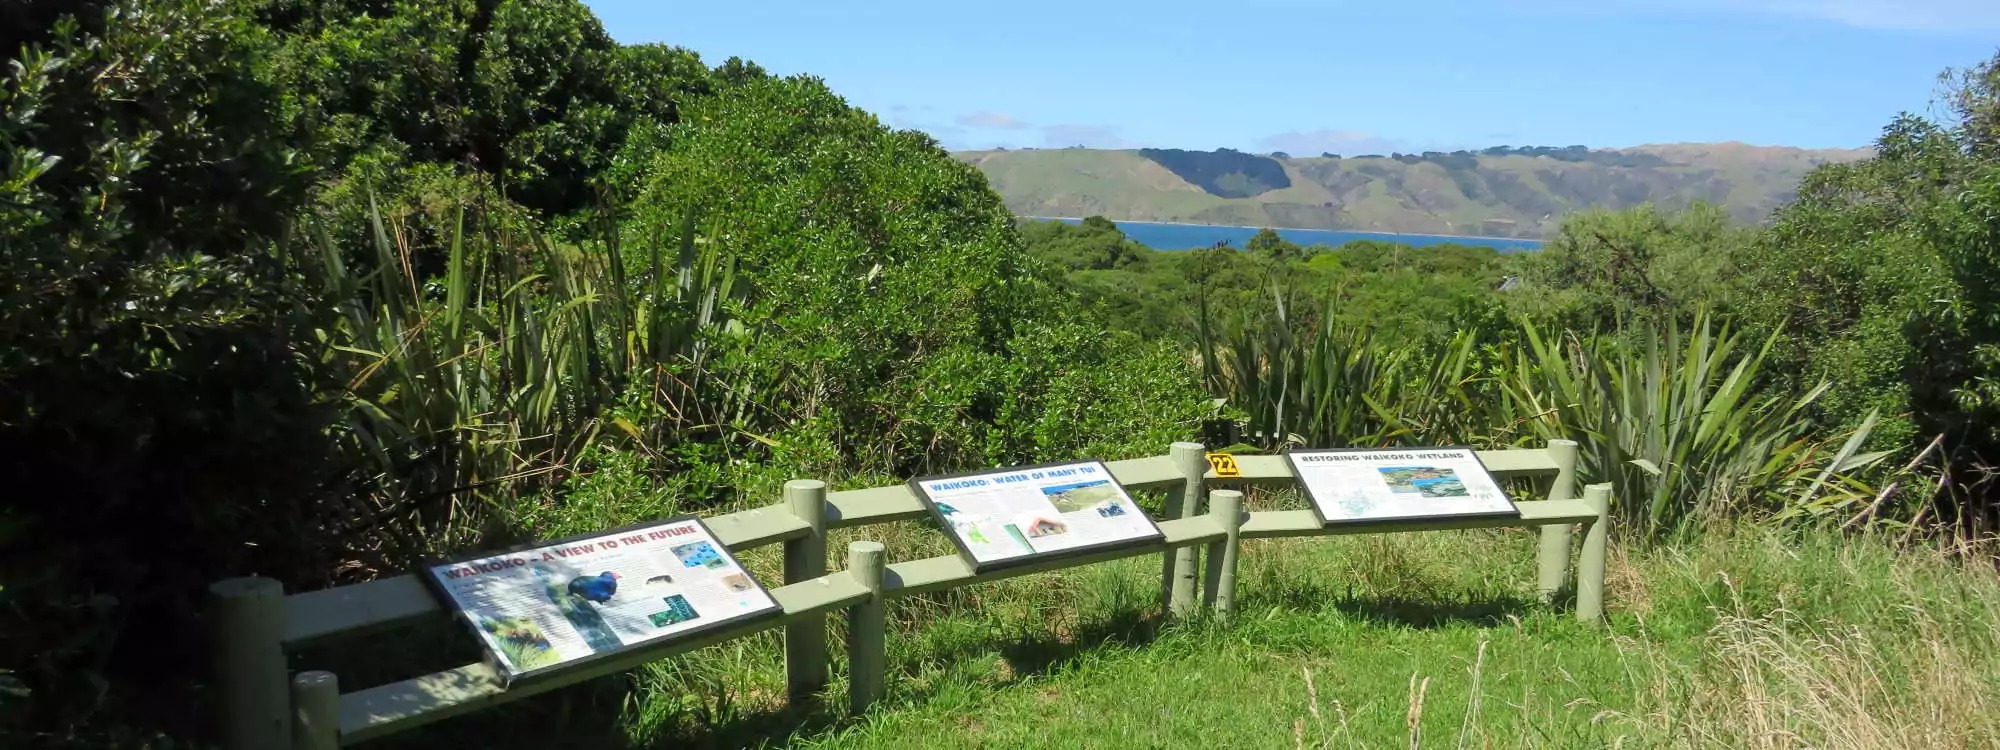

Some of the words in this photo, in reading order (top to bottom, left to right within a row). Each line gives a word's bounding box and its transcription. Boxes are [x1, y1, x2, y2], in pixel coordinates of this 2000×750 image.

[1212, 456, 1237, 474] 22
[1361, 453, 1414, 461] WAIKOKO
[1416, 452, 1465, 460] WETLAND
[930, 479, 991, 492] WAIKOKO:
[993, 473, 1030, 485] WATER
[1031, 471, 1045, 480] OF
[1047, 468, 1078, 478] MANY
[1080, 466, 1097, 475] TUI
[443, 557, 526, 579] WAIKOKO
[542, 552, 556, 562] A
[555, 543, 596, 559] VIEW
[598, 540, 618, 551] TO
[620, 534, 648, 546] THE
[649, 525, 697, 541] FUTURE
